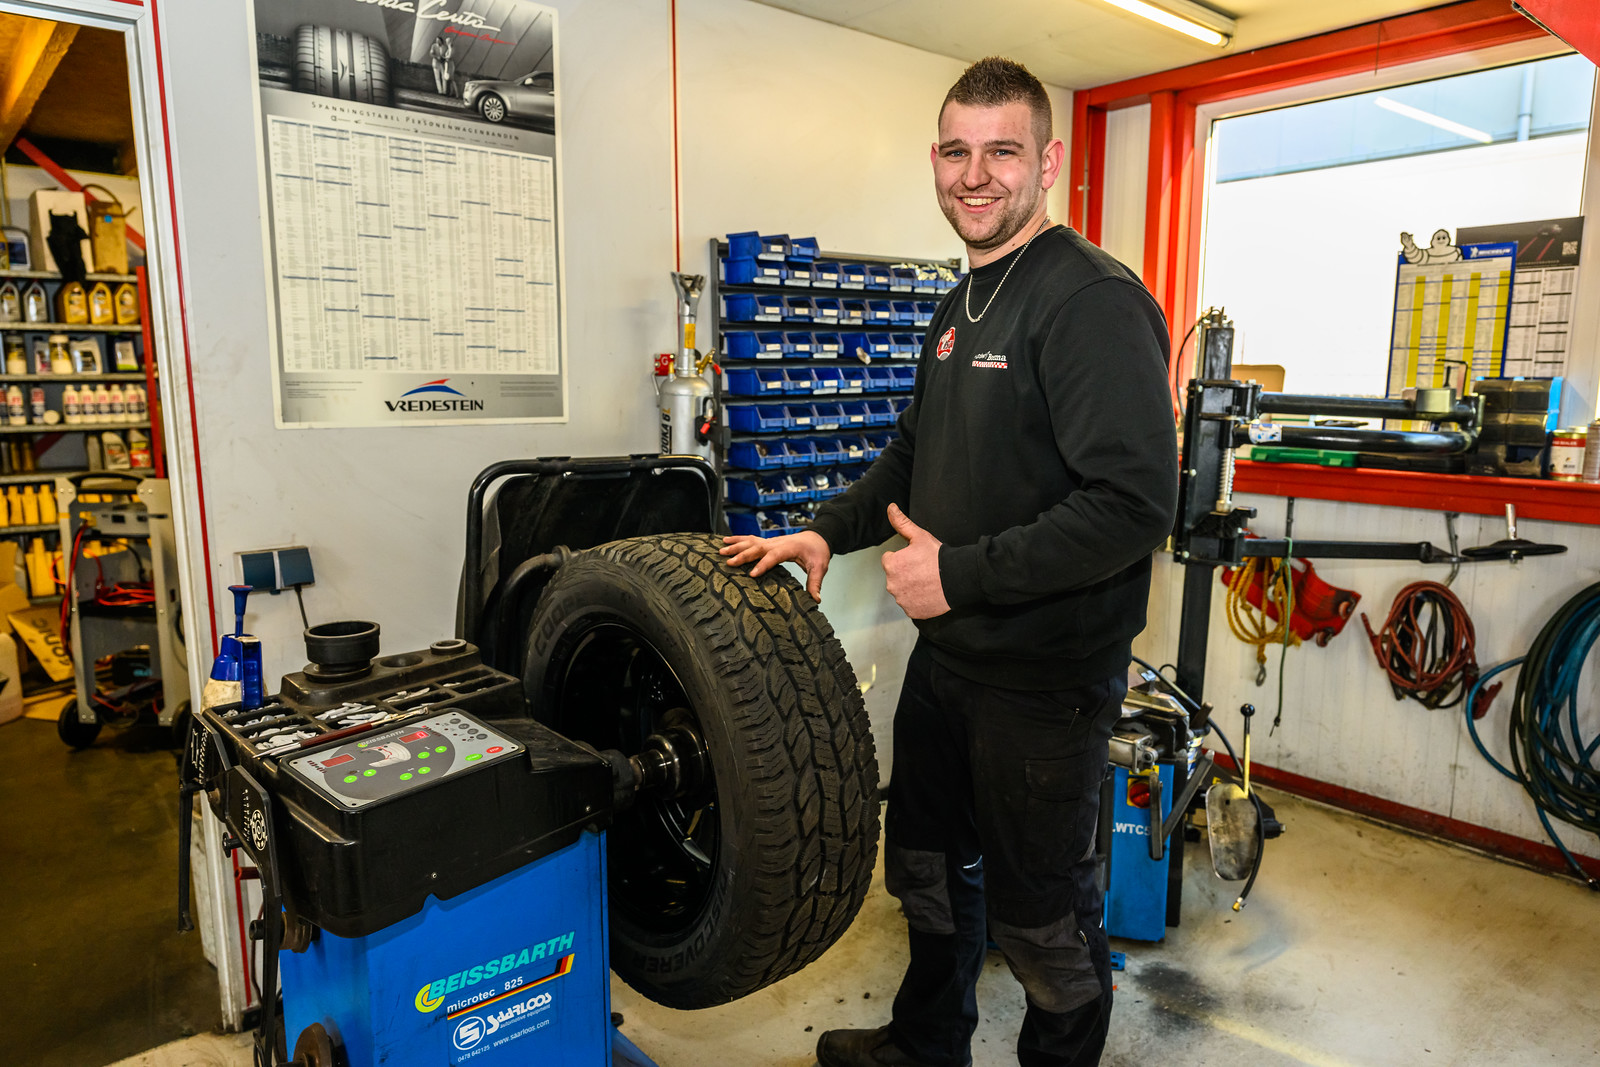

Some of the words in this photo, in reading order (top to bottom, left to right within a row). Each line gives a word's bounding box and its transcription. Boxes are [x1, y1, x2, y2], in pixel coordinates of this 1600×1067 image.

[384, 399, 484, 412] VREDESTEIN
[361, 730, 405, 746] BEISSBARTH
[428, 931, 575, 1001] BEISSBARTH
[447, 989, 496, 1014] microtec
[504, 976, 524, 991] 825
[500, 1014, 526, 1029] automotive
[526, 1004, 551, 1019] equipment
[493, 1019, 550, 1047] www.saarloos.com
